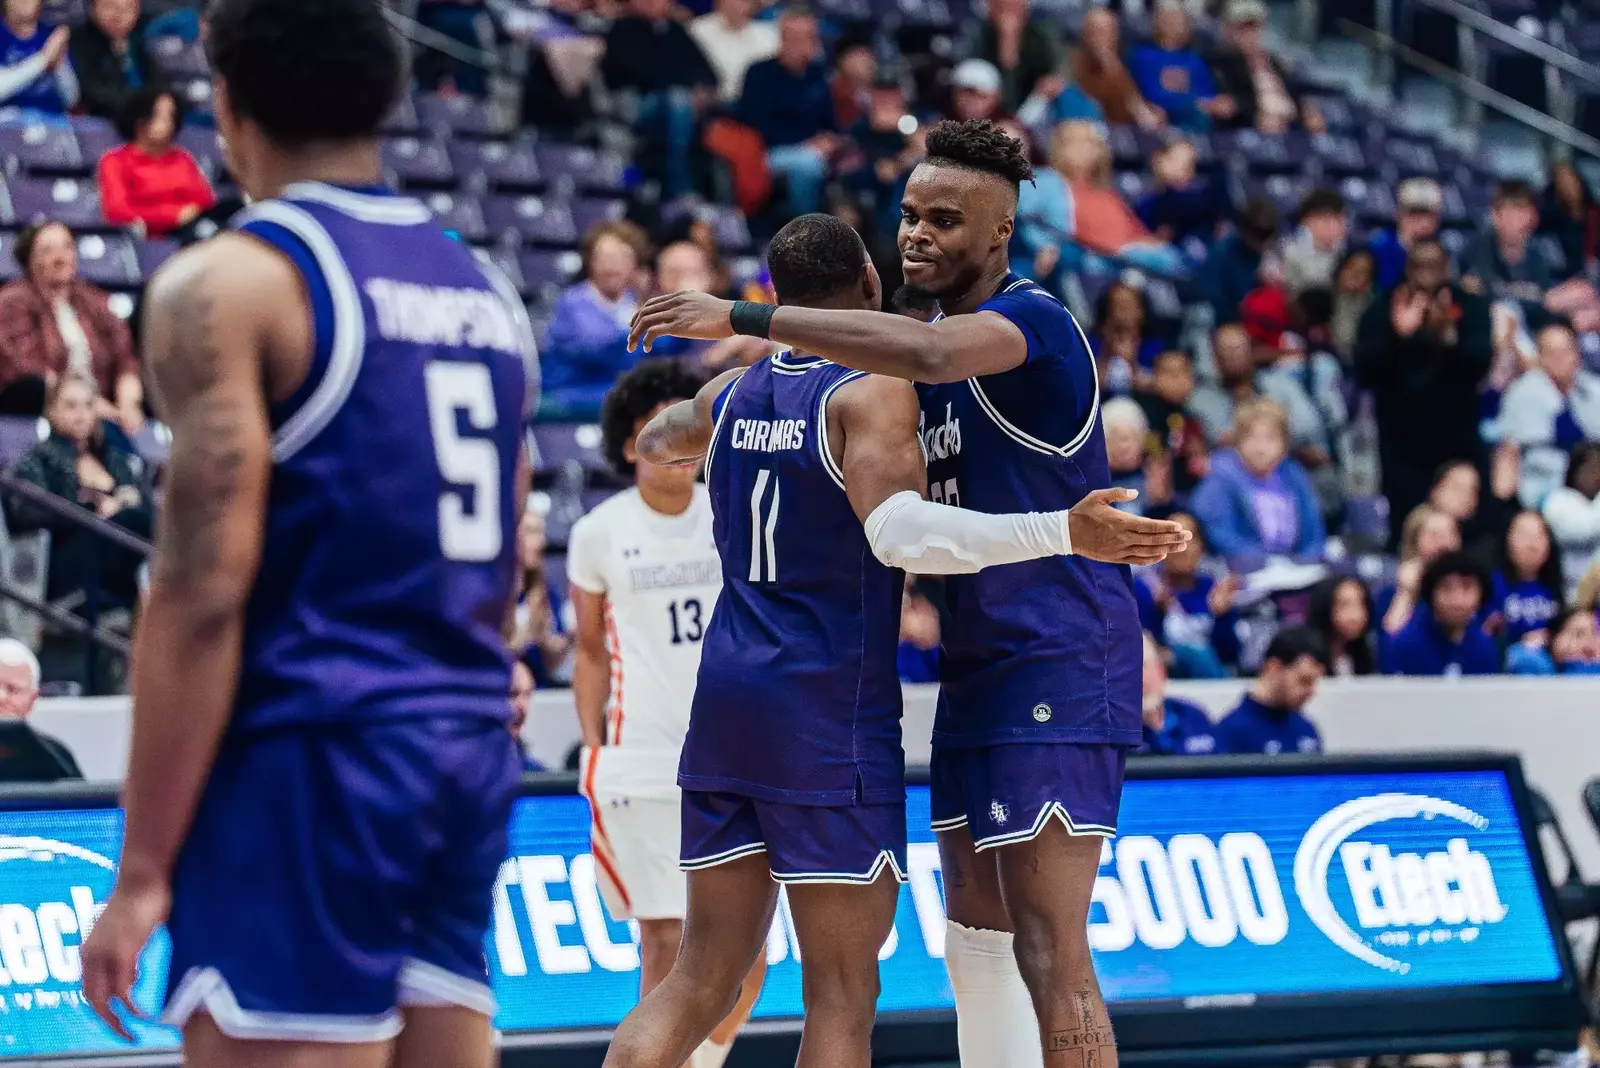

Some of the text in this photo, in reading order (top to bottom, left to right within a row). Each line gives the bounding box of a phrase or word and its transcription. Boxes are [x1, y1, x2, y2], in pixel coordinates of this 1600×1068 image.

[423, 359, 502, 562] 5
[748, 469, 780, 582] 11
[667, 598, 703, 645] 13
[1339, 838, 1505, 929] Etech
